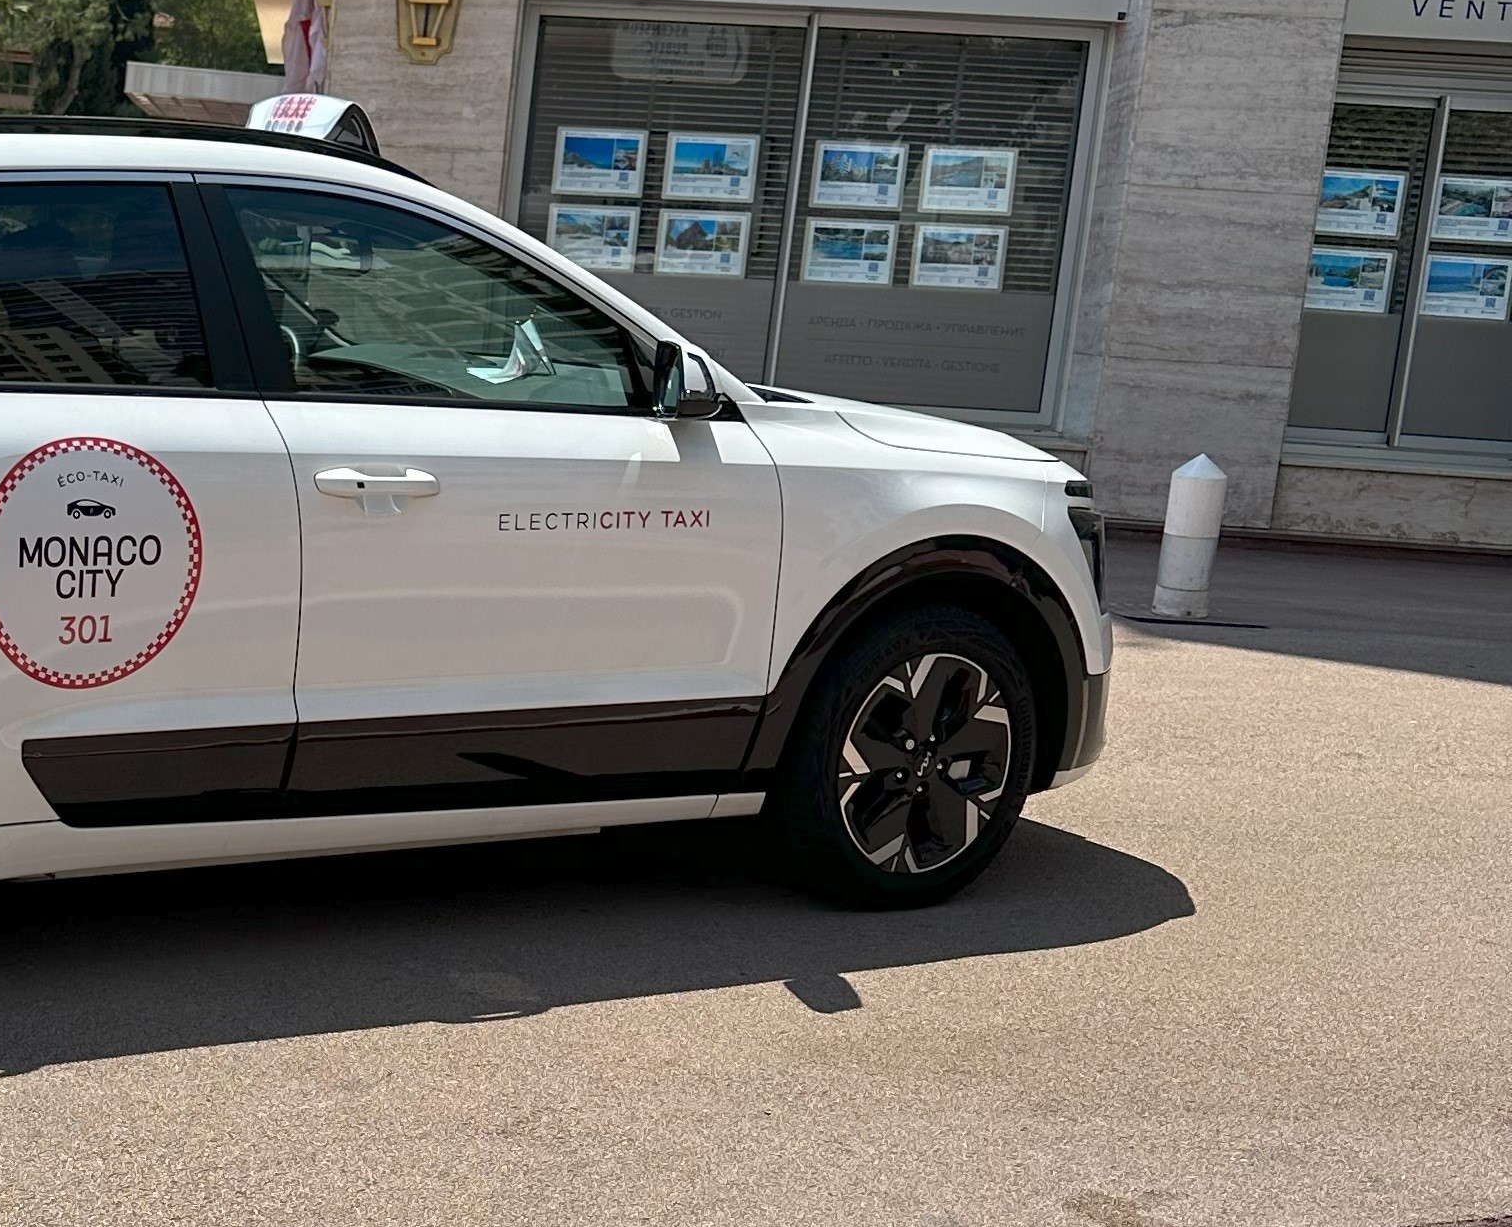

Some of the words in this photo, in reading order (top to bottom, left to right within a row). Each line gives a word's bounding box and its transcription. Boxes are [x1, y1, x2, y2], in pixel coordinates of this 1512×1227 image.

[670, 307, 722, 320] GESTION
[498, 510, 651, 532] ELECTRICITY
[660, 509, 710, 529] TAXI
[18, 534, 162, 568] MONACO
[55, 568, 124, 600] CITY
[58, 614, 113, 645] 301
